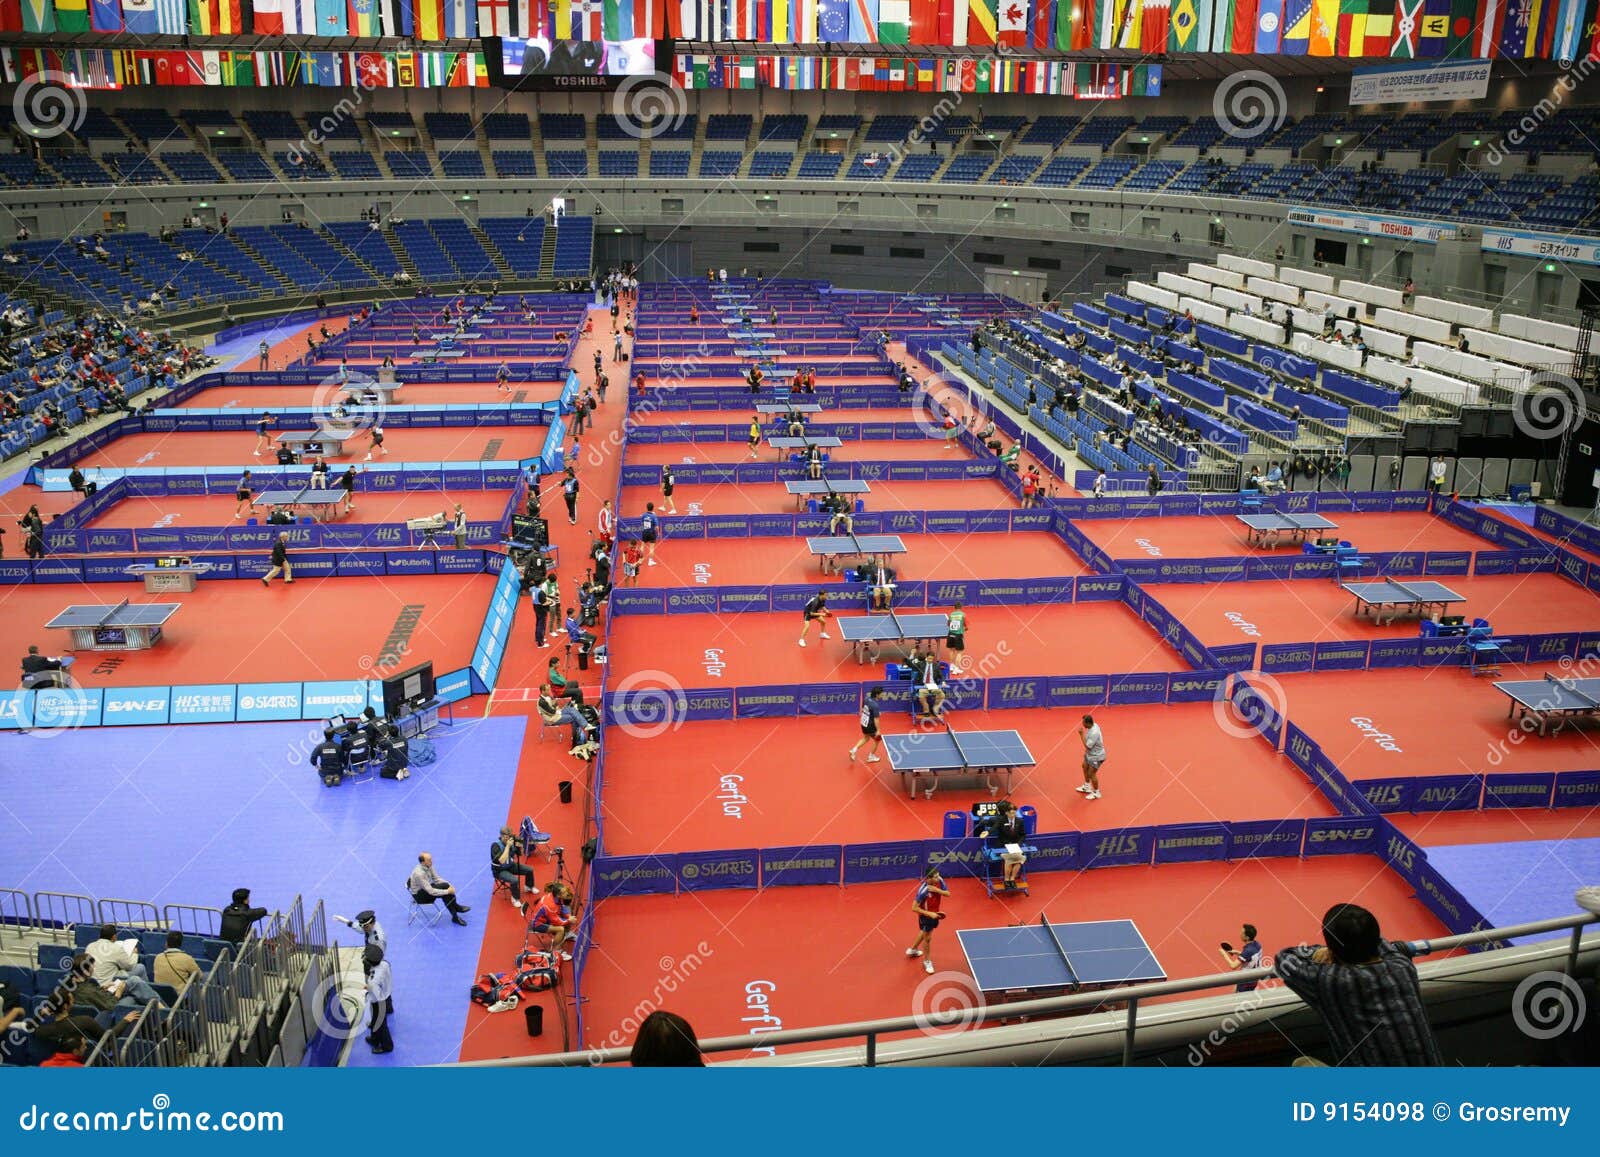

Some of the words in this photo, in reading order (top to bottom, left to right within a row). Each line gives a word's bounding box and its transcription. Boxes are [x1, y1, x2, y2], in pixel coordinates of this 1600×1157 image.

[553, 76, 607, 86] TOSHIBA
[1289, 213, 1315, 222] LIEBHERR
[1380, 223, 1413, 236] TOSHIBA
[1497, 237, 1513, 249] HIS
[861, 465, 881, 475] HIS
[374, 475, 396, 486] HIS
[1288, 496, 1308, 508] HIS
[892, 514, 917, 527] HIS
[1013, 515, 1050, 523] SAN-EI
[375, 527, 401, 540] HIS
[467, 525, 493, 539] HIS
[1482, 519, 1499, 537] HIS
[48, 534, 77, 546] HIS
[91, 535, 117, 545] ANA
[439, 555, 456, 564] HIS
[1389, 556, 1416, 568] HIS
[1564, 557, 1583, 573] HIS
[938, 585, 967, 600] HIS
[1079, 583, 1122, 592] SAN-EI
[827, 591, 867, 600] SAN-E
[1224, 611, 1262, 637] Gerflor
[1539, 638, 1569, 653] HIS
[705, 648, 727, 678] Gerflor
[1001, 682, 1037, 700] HIS
[1051, 685, 1104, 696] LIEBHERR
[1172, 680, 1222, 690] SAN-EI
[107, 700, 166, 712] SAN-EI
[255, 695, 298, 709] STARTS
[306, 694, 363, 705] LIEBHERR
[689, 697, 731, 710] STARTS
[738, 694, 795, 705] LIEBHERR
[1350, 716, 1403, 752] Gerflor
[1291, 734, 1313, 763] HIS
[1364, 785, 1404, 804] HIS
[1418, 787, 1457, 802] ANA
[1487, 784, 1547, 795] LIEBHERR
[1559, 784, 1600, 794] TOSHI
[720, 774, 748, 819] Gerflor
[1308, 828, 1374, 842] SAN-EI
[1095, 833, 1141, 856] HIS
[1158, 835, 1225, 849] LIEBHERR
[1387, 836, 1417, 870] HIS
[700, 860, 754, 876] STARTS
[764, 858, 836, 872] LIEBHERR
[621, 867, 671, 880] Butterfly
